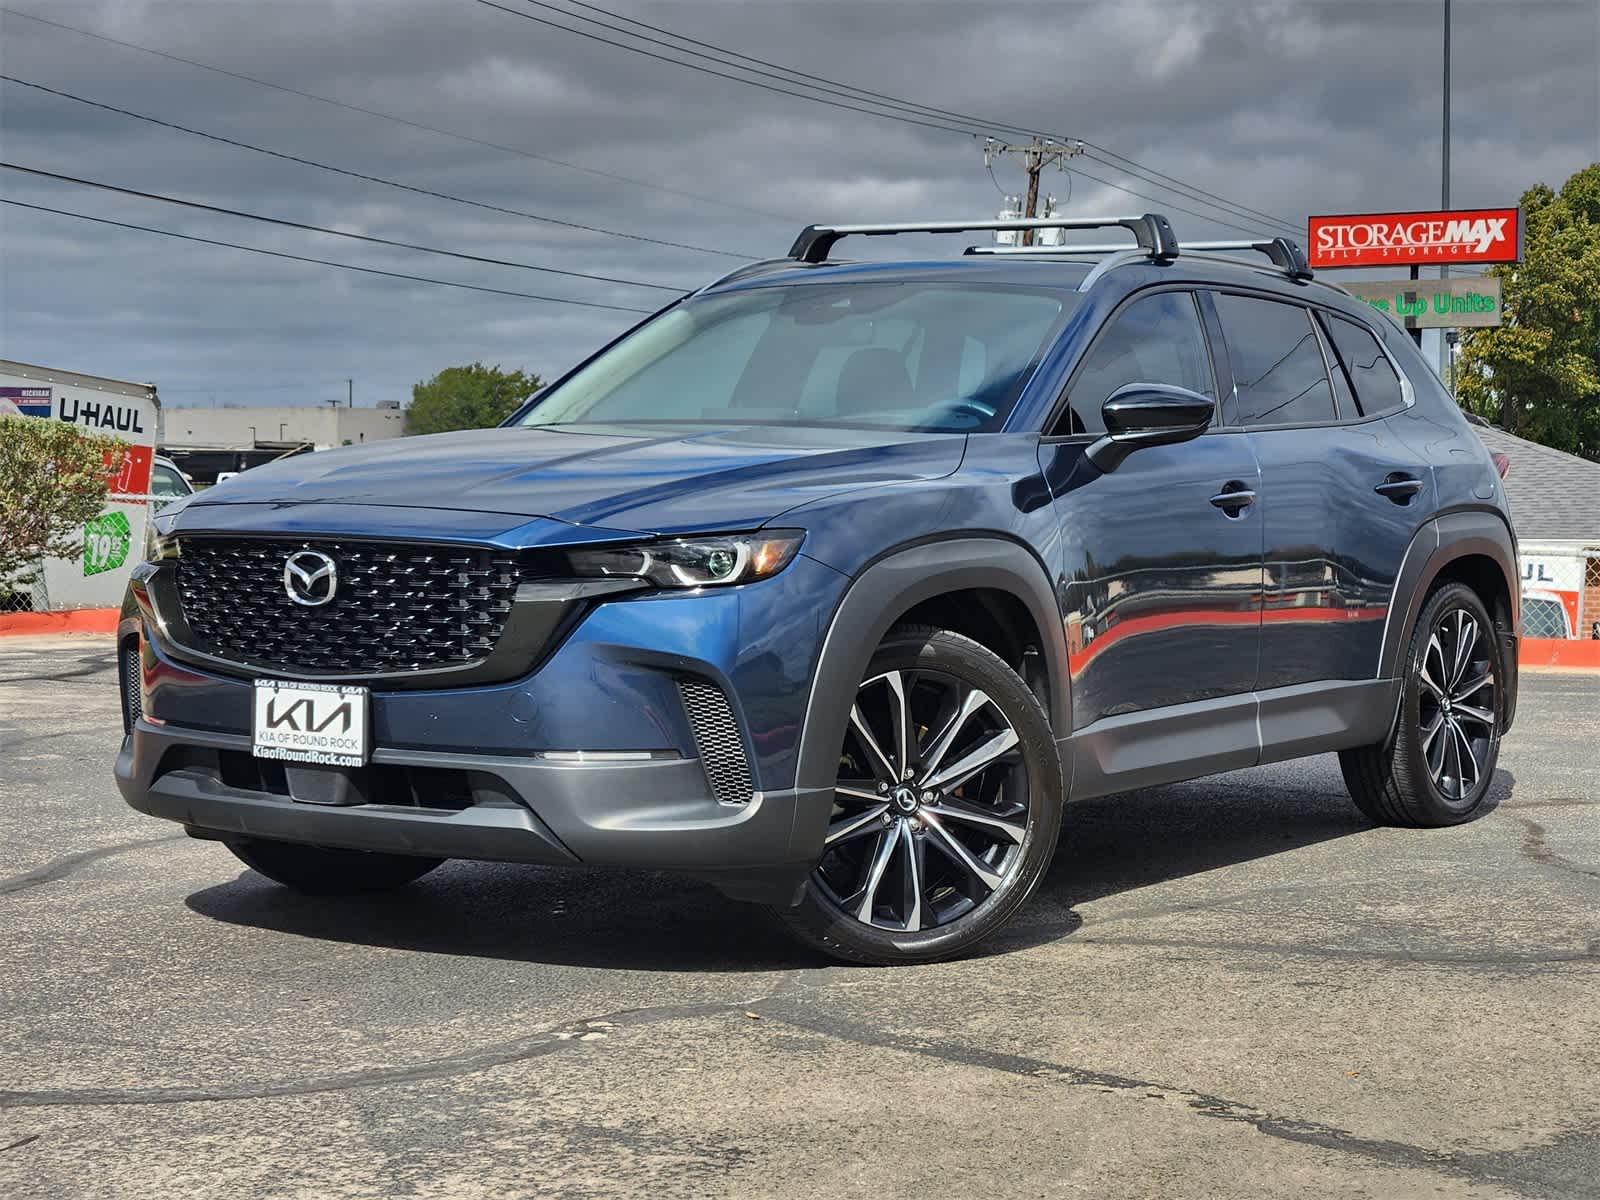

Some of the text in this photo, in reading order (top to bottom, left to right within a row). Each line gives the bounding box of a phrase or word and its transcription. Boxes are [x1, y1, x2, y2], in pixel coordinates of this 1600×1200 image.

[1317, 245, 1472, 258] SELF STORAGE
[1396, 294, 1427, 317] Up
[1433, 291, 1496, 315] Units
[59, 397, 143, 434] U-HAUL
[266, 697, 351, 734] KIA
[259, 731, 359, 750] KIA OF ROUND ROCK
[253, 744, 363, 768] KiaofRoundRock.com
